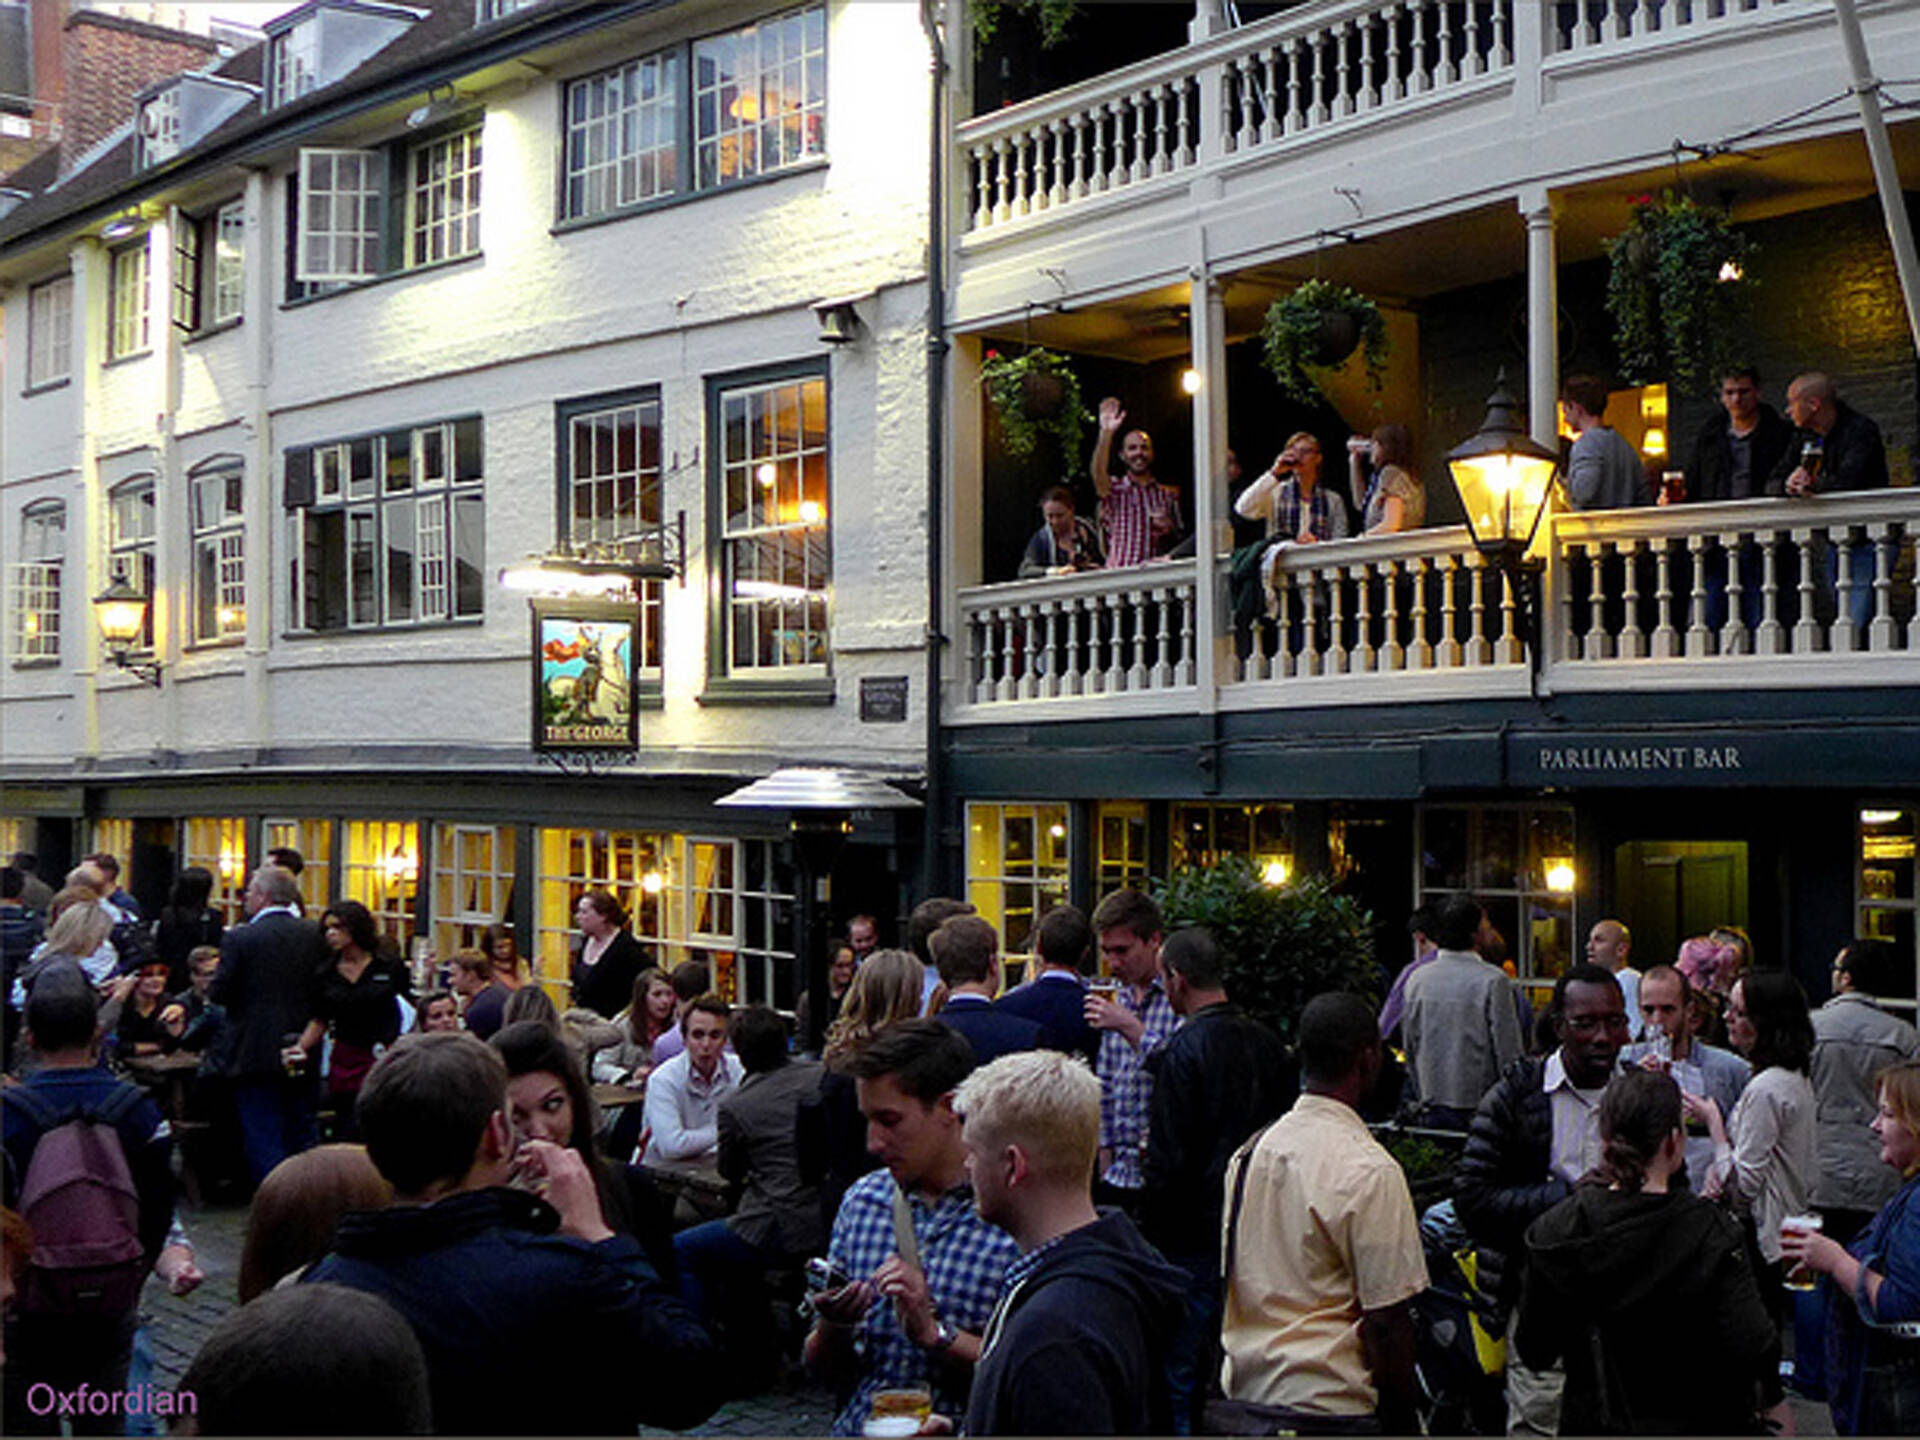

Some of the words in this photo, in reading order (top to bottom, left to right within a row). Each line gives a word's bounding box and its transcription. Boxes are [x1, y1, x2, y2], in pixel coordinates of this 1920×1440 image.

[545, 726, 570, 741] THE
[573, 725, 627, 741] GEORGE
[1540, 748, 1686, 769] PARLIAMENT
[1693, 747, 1741, 768] BAR
